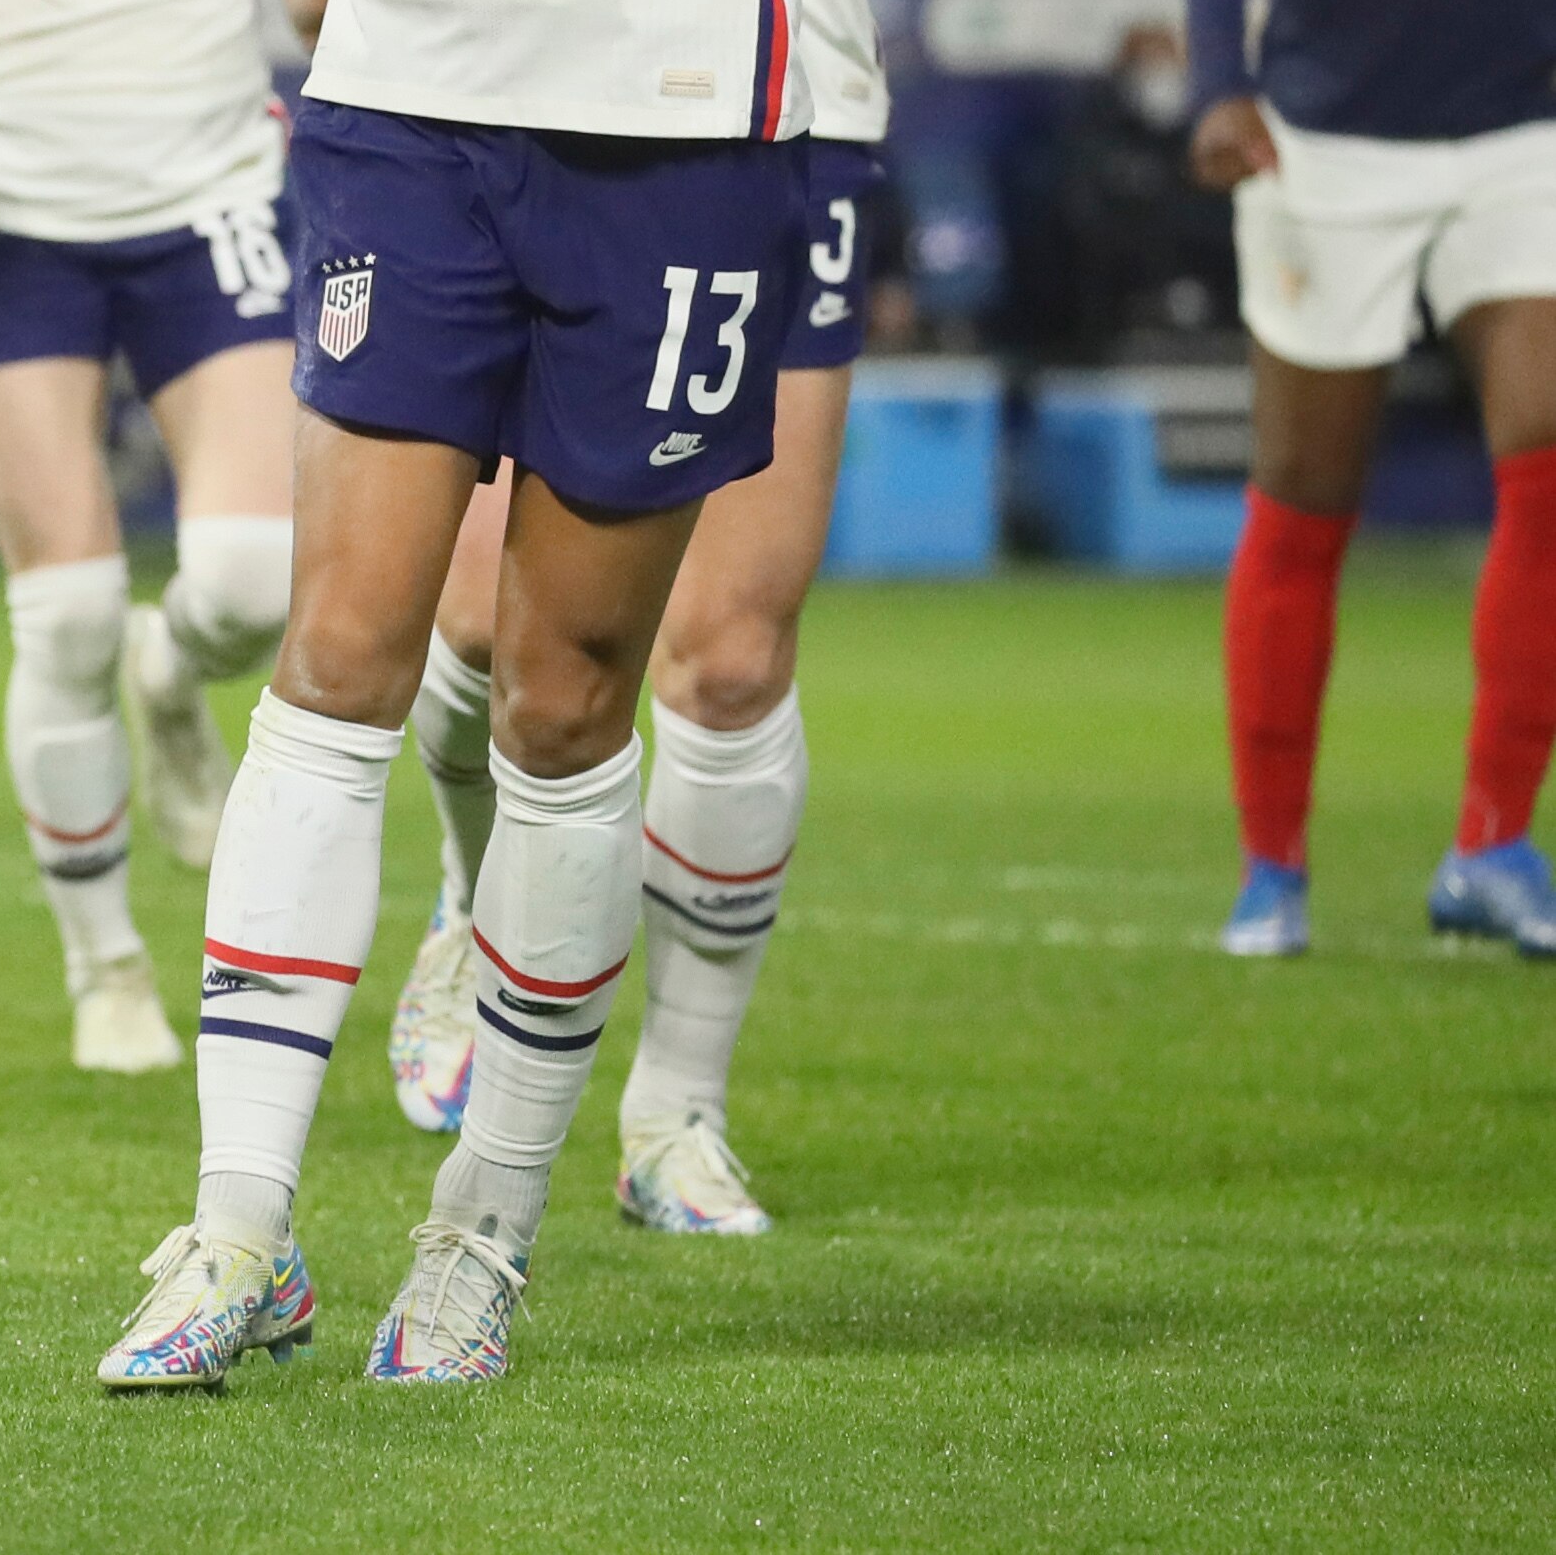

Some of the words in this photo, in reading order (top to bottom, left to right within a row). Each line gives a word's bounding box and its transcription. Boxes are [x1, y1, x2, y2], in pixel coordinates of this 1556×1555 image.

[192, 201, 292, 297] 16
[326, 276, 369, 311] USA
[645, 265, 759, 416] 13
[661, 431, 703, 454] NIKE
